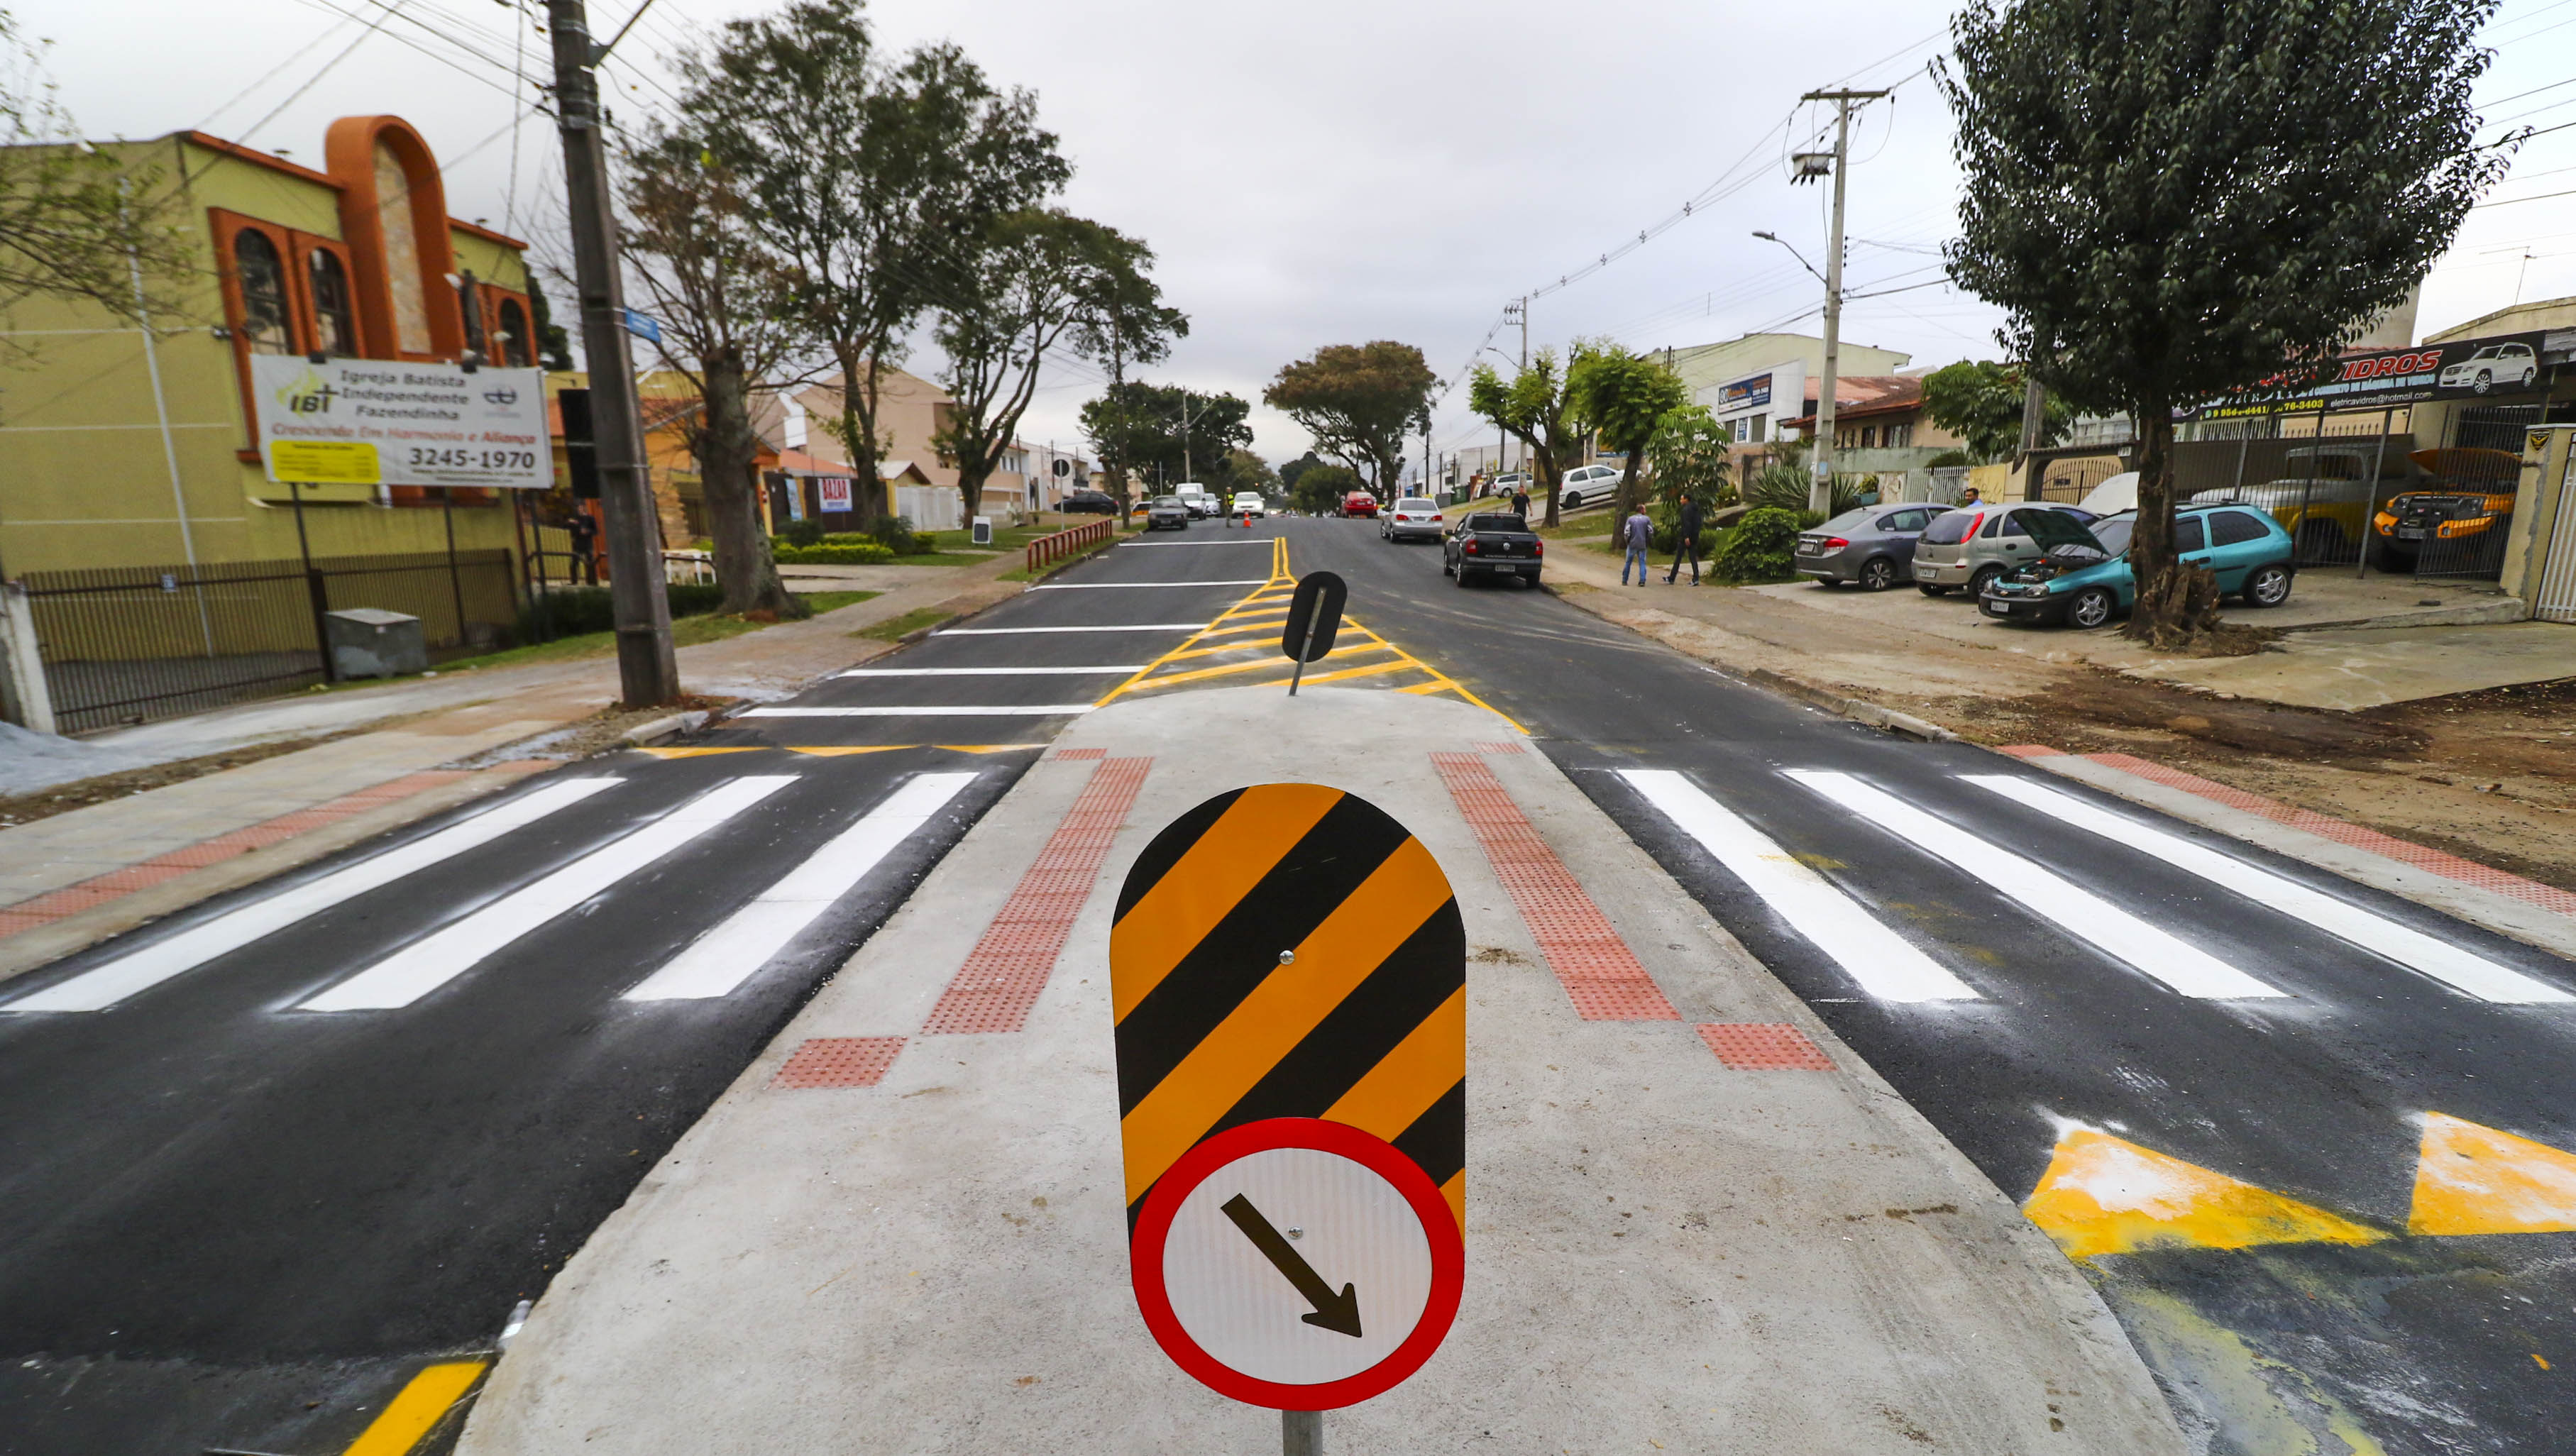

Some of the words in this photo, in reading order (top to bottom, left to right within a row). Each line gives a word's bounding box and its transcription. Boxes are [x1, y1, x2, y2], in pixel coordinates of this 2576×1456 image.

[2332, 349, 2443, 383] IDROS
[342, 370, 397, 386] Igreja
[404, 373, 466, 387] Batista
[342, 388, 469, 404] Independente
[356, 405, 460, 420] Fazendinha
[468, 433, 476, 442] e
[482, 431, 536, 446] Aliança
[409, 447, 535, 468] 3245-1970
[822, 479, 847, 500] BAZAR
